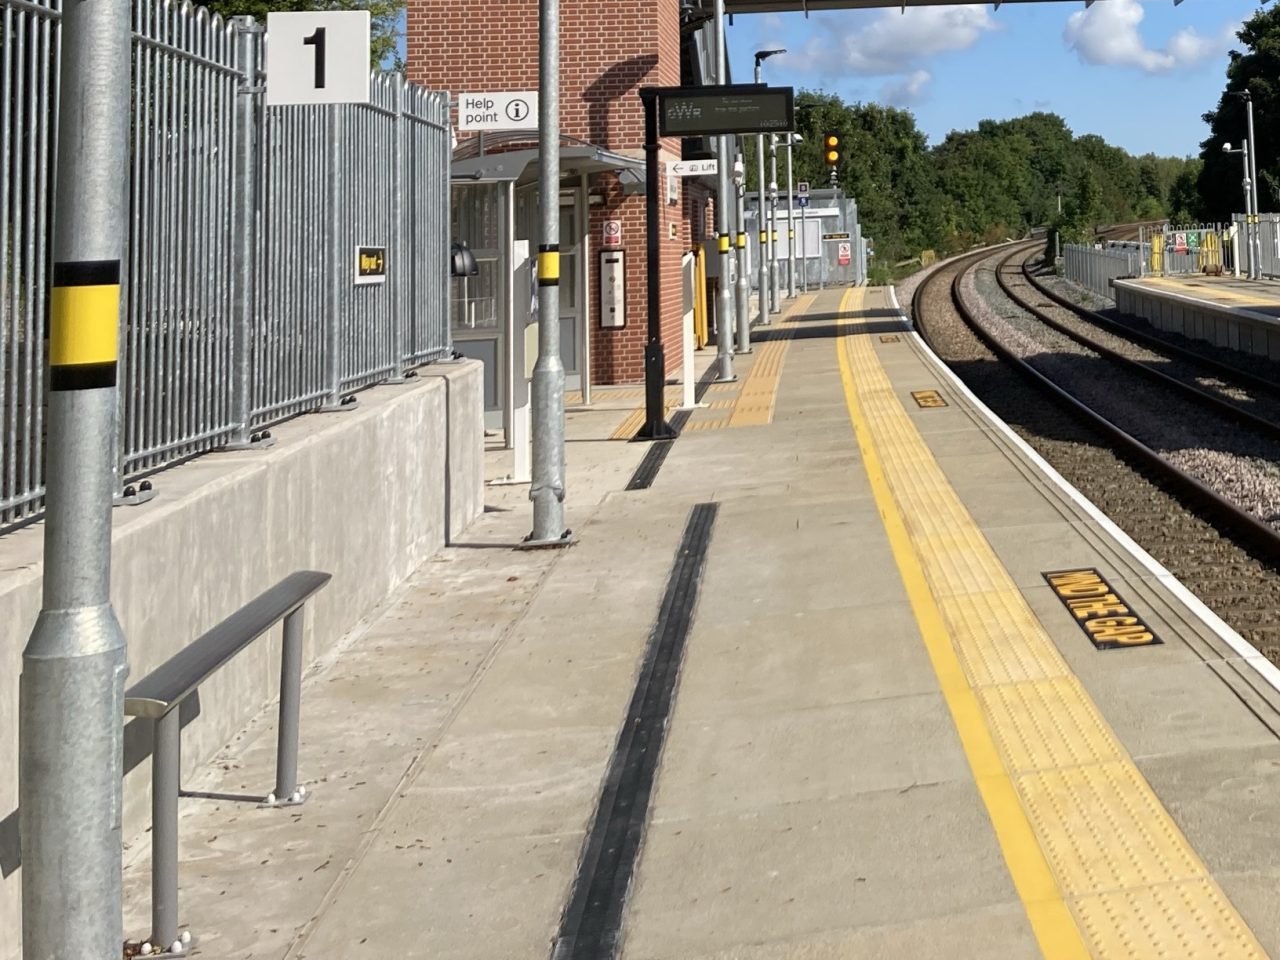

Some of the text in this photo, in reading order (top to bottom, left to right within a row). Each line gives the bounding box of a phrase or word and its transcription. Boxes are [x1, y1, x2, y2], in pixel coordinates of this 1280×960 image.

[303, 27, 326, 89] 1
[466, 98, 494, 111] Help
[466, 112, 498, 126] point
[702, 162, 716, 172] Lift
[1066, 593, 1128, 619] THE
[1084, 616, 1154, 645] GAP
